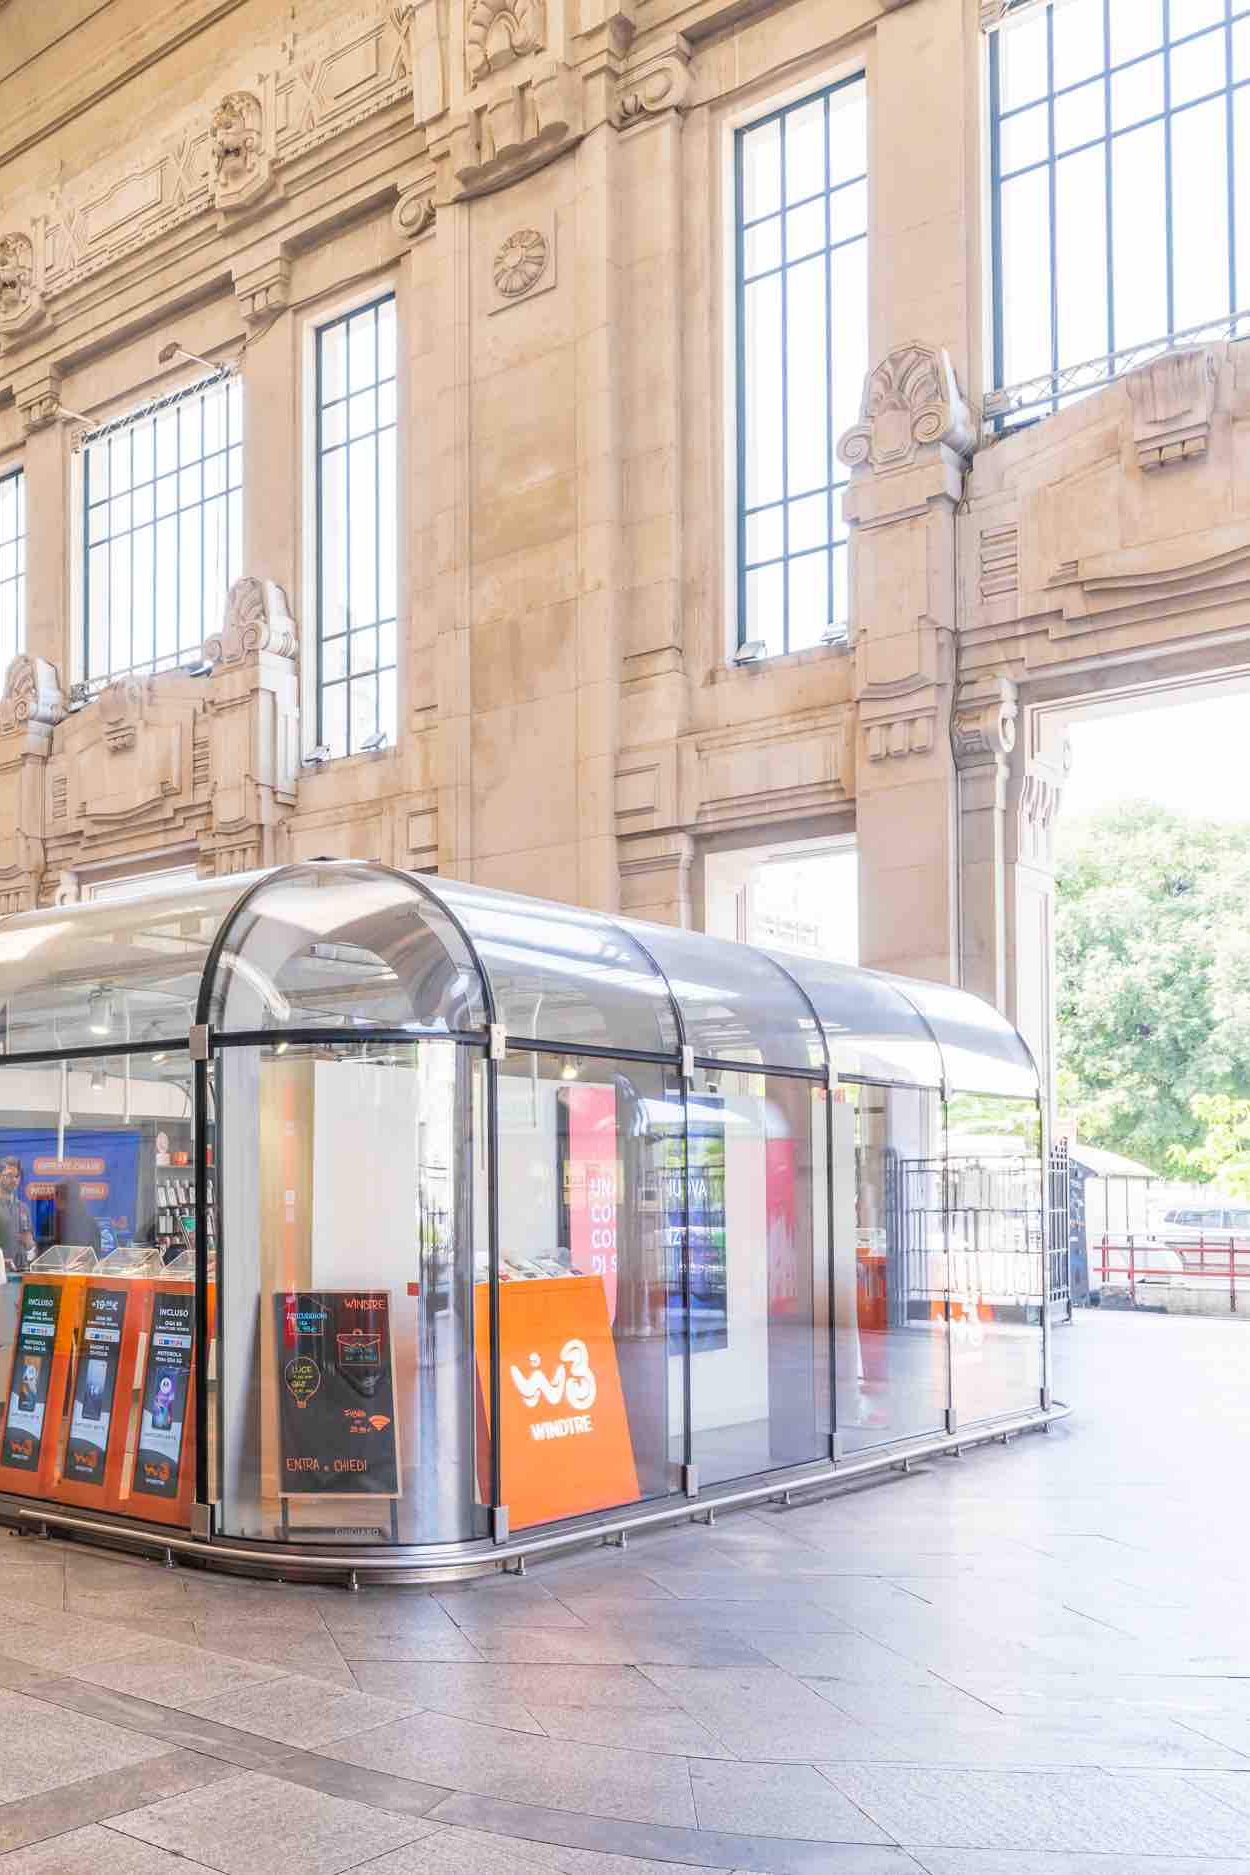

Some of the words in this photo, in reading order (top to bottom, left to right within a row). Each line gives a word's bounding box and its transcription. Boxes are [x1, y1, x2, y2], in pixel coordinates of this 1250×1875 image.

[159, 1307, 189, 1318] INCLUSO
[530, 1414, 594, 1441] WINDTRE
[286, 1458, 320, 1472] ENTRA
[333, 1458, 367, 1473] CHIEDI
